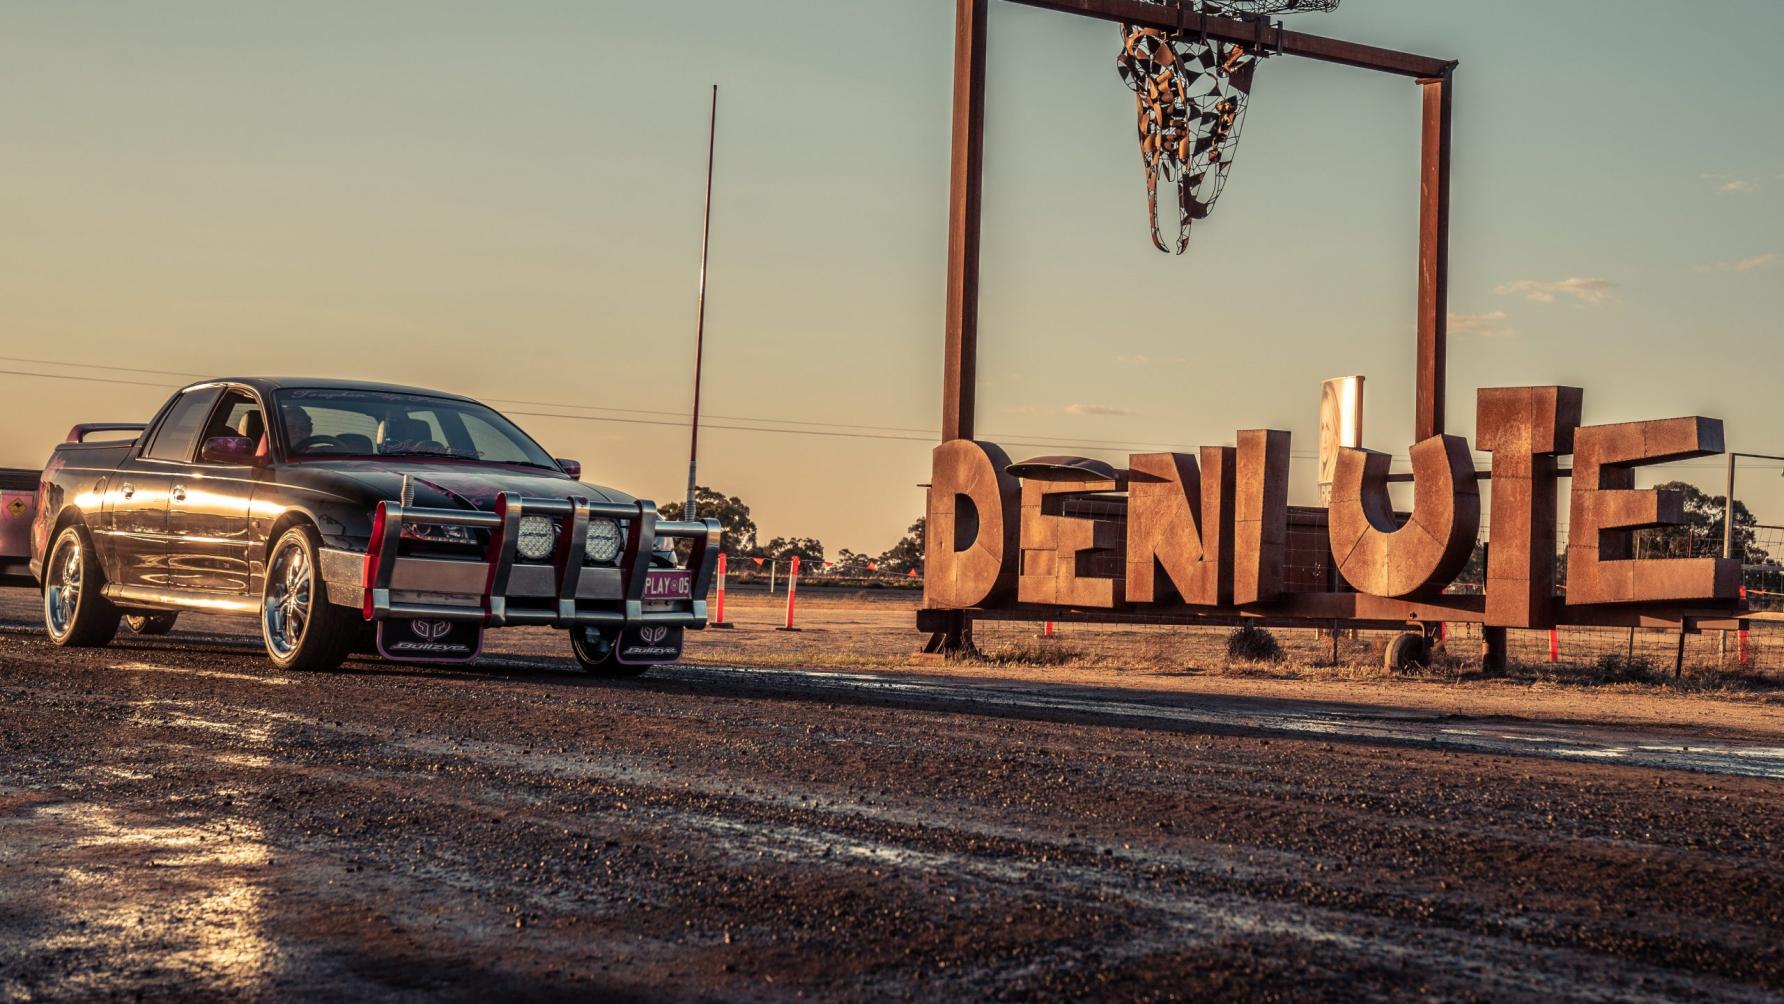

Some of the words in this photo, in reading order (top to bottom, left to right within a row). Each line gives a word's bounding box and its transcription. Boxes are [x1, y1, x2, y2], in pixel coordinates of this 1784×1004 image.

[923, 429, 1291, 609] DENI
[1328, 385, 1741, 627] UTE
[644, 577, 671, 595] PLAY
[678, 577, 690, 594] 05
